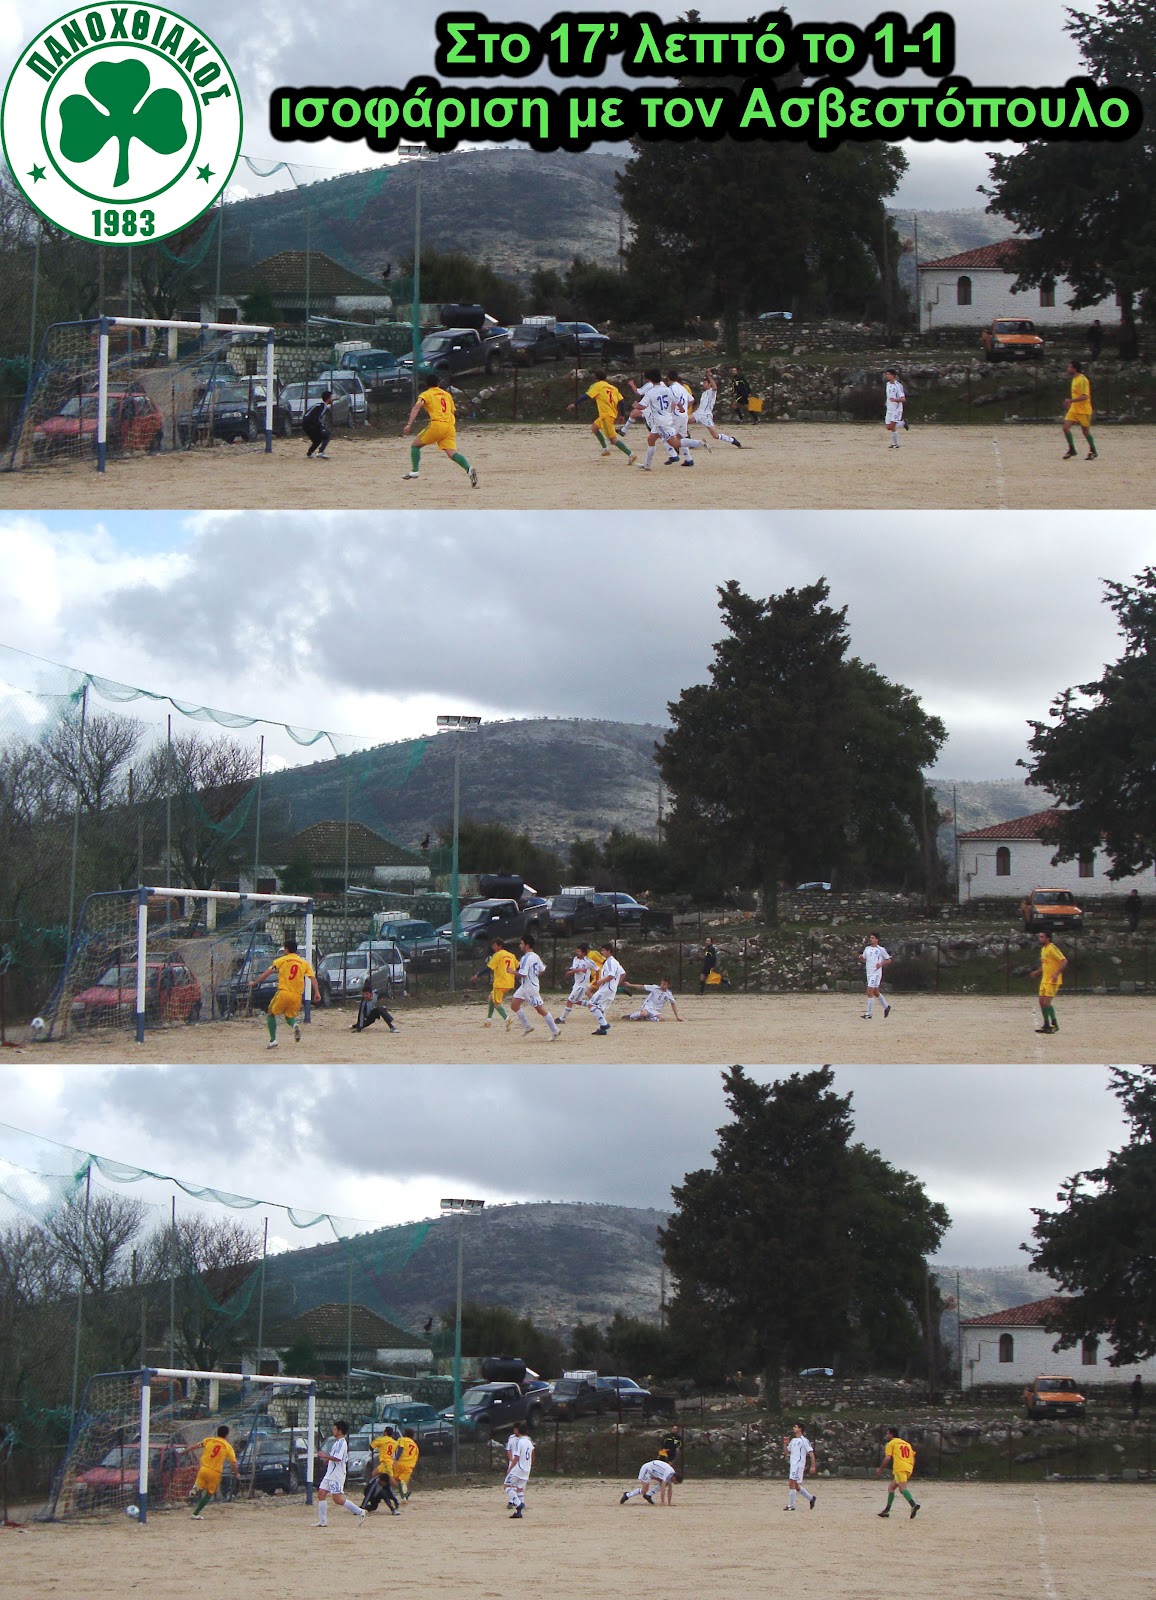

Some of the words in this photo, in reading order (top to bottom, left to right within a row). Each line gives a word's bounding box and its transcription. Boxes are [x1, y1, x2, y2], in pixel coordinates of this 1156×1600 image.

[440, 397, 447, 413] 9
[657, 395, 669, 410] 15
[288, 964, 299, 980] 9
[210, 1445, 221, 1458] 9
[387, 1444, 393, 1456] 8
[408, 1444, 415, 1456] 7
[525, 1447, 531, 1461] 6
[900, 1445, 910, 1459] 10
